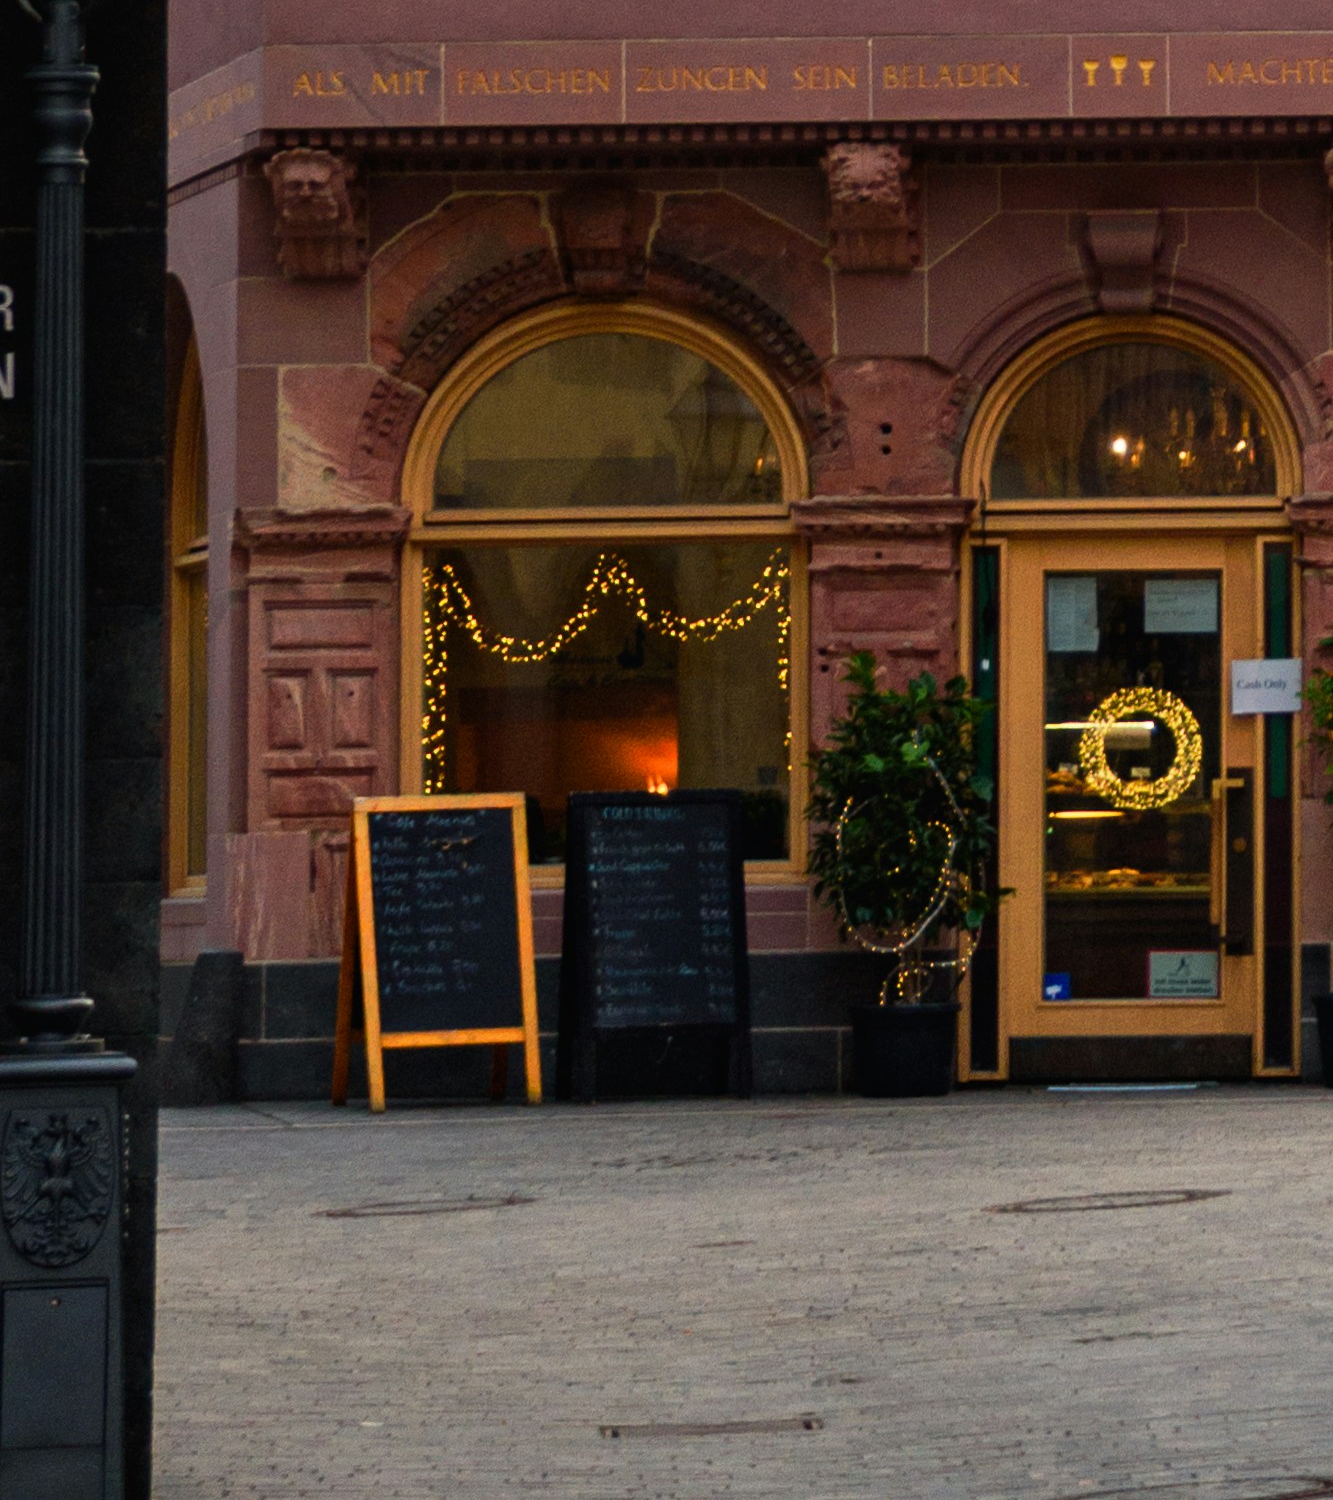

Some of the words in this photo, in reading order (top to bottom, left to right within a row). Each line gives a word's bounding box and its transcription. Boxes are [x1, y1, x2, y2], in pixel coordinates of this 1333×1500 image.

[294, 70, 347, 97] ALS
[371, 69, 429, 96] MIT
[457, 68, 612, 95] FALSCHEN
[792, 63, 859, 90] SEIN
[1236, 679, 1261, 690] Cash
[1264, 679, 1287, 691] Only
